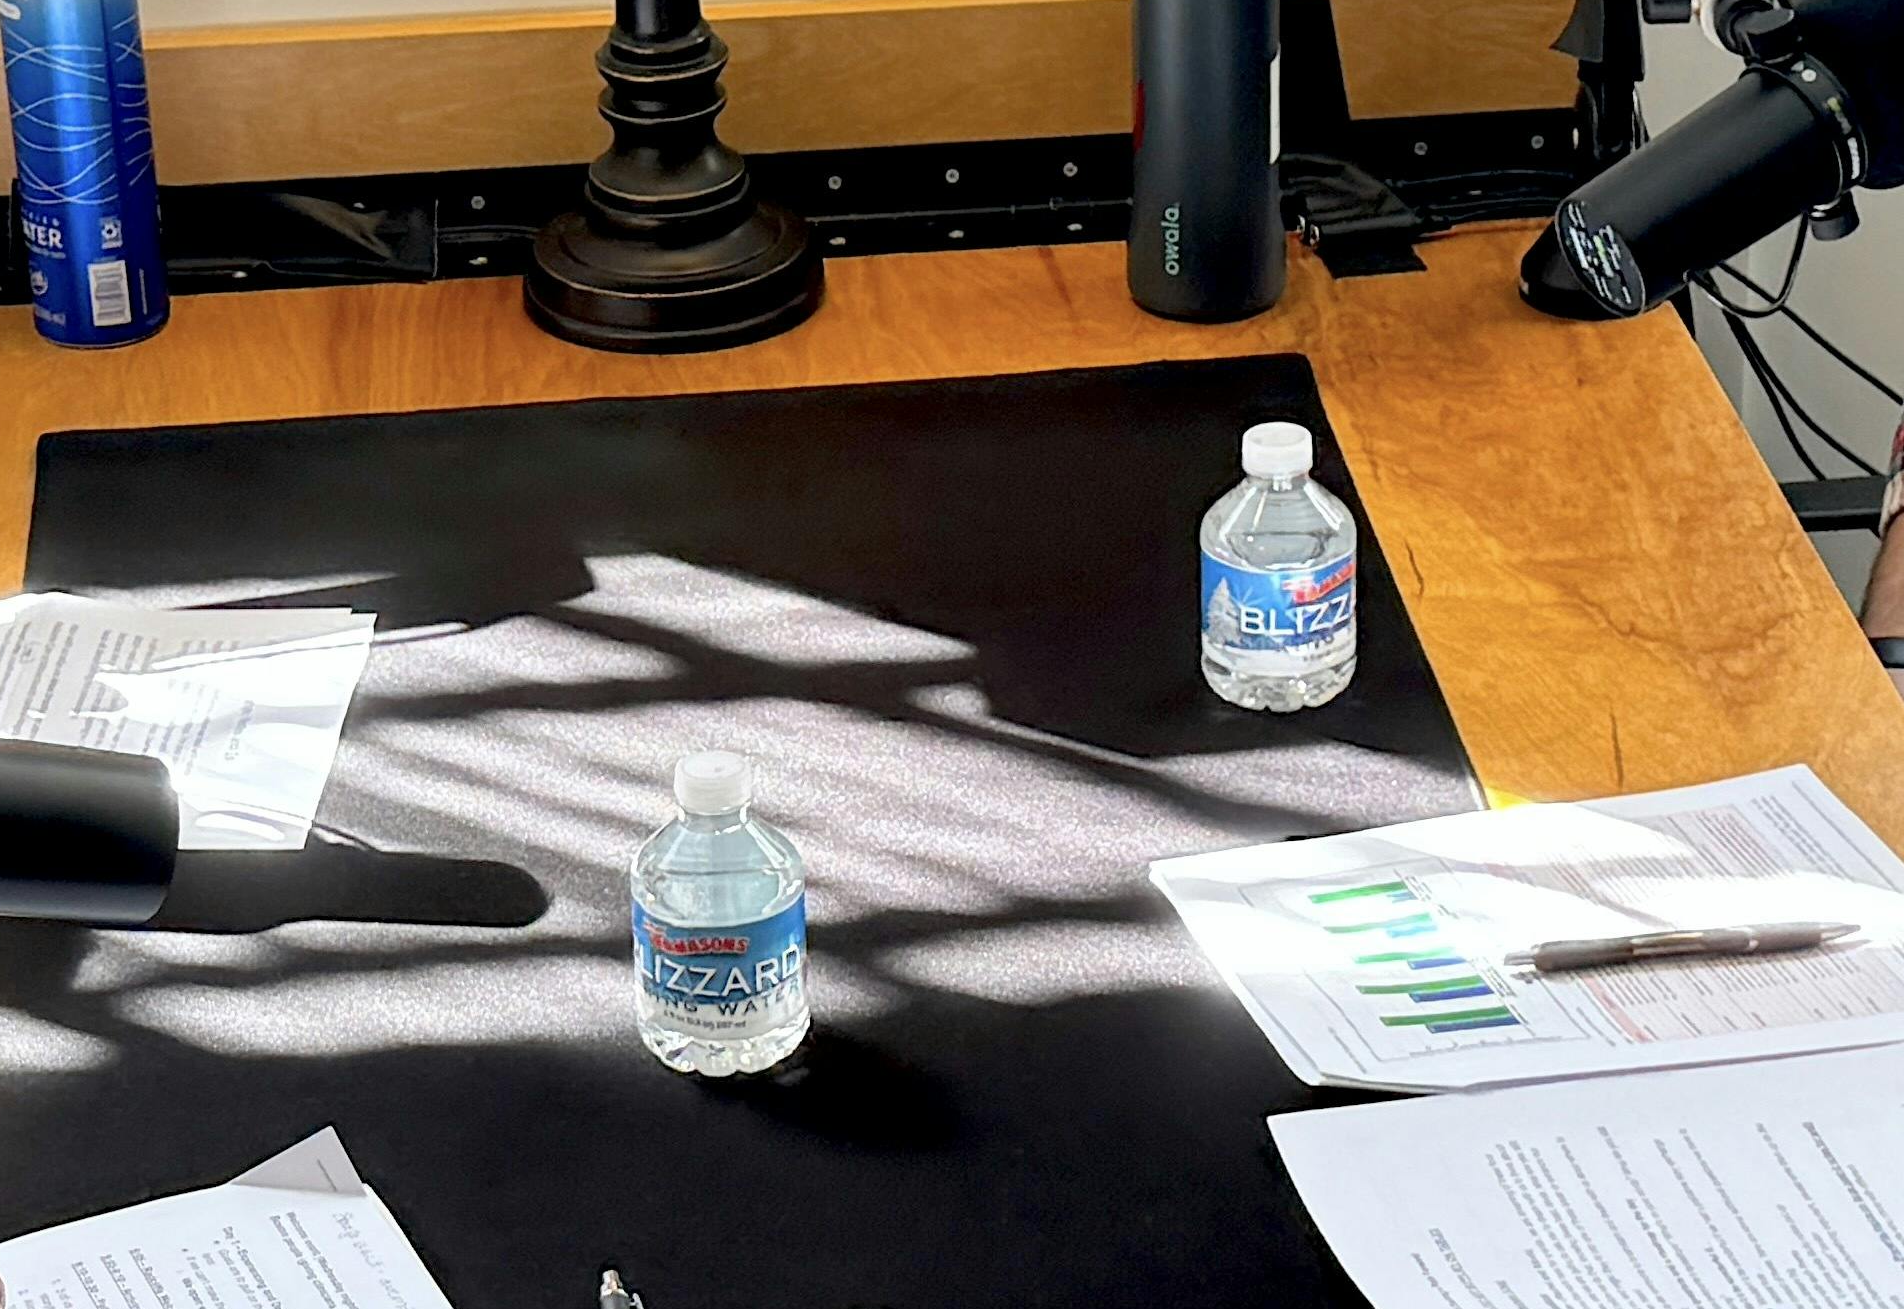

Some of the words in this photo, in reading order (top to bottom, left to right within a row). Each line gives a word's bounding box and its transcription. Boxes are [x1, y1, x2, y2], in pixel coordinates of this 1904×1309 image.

[22, 217, 63, 249] ATER
[1161, 203, 1180, 276] owala
[1240, 592, 1352, 636] BLIZZ
[636, 942, 801, 998] LIZZARD
